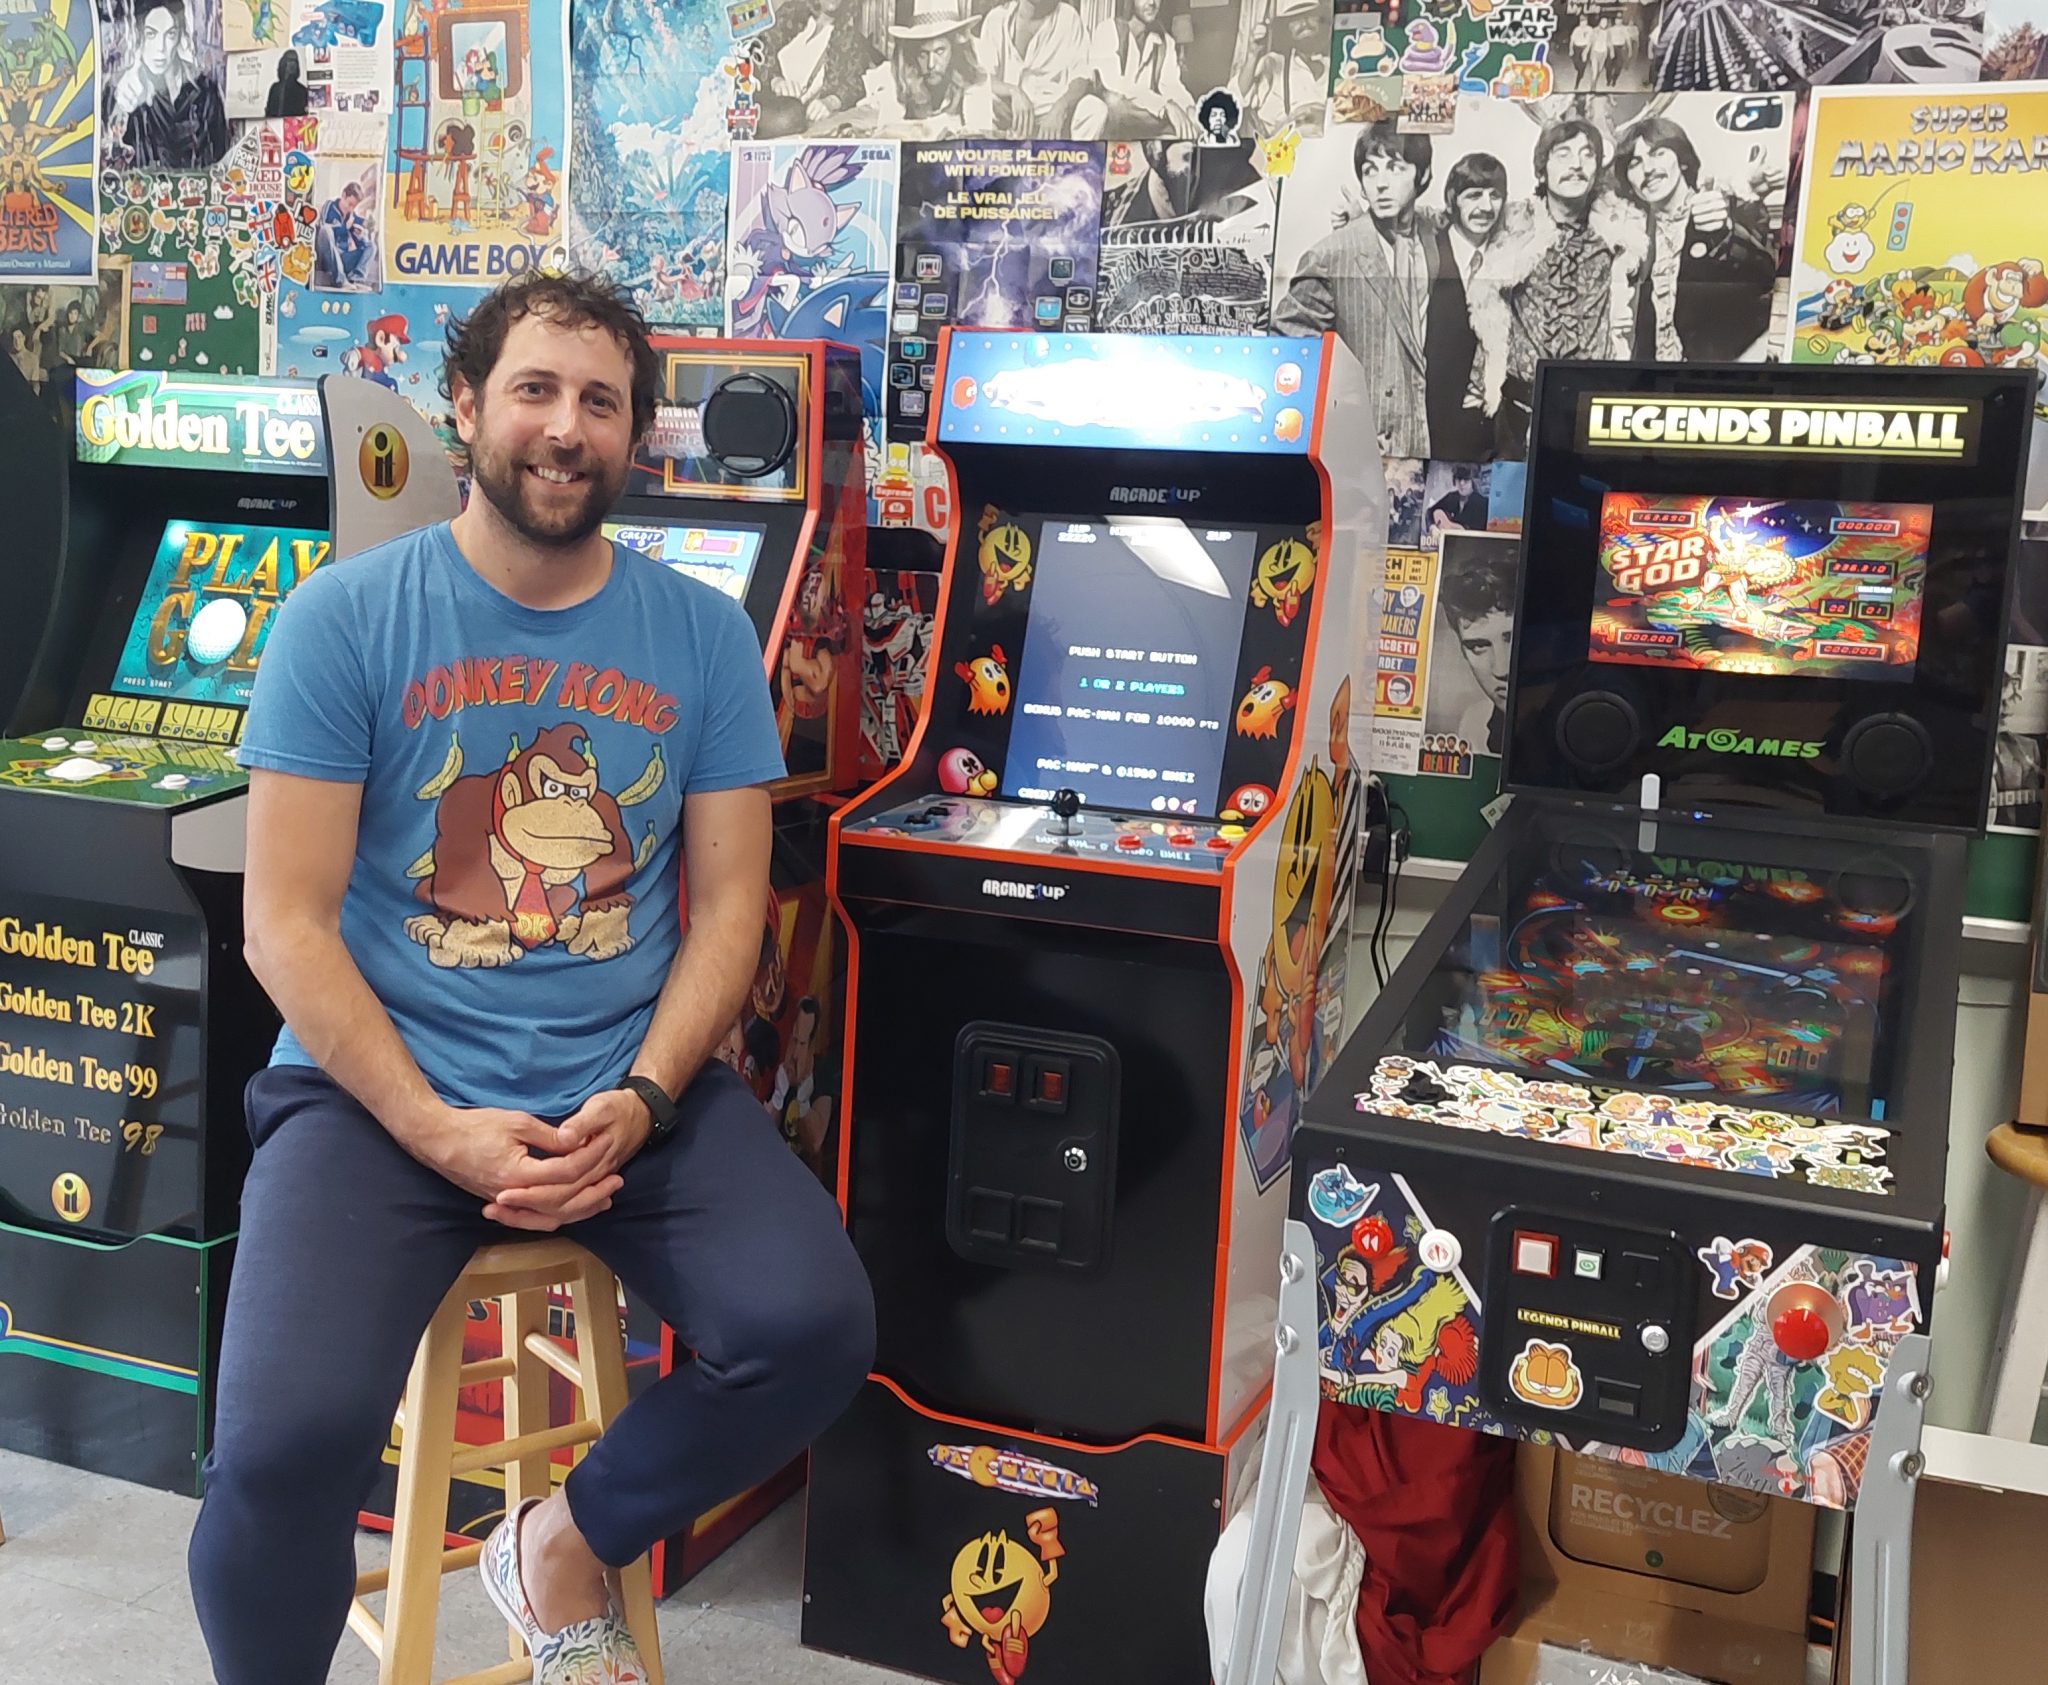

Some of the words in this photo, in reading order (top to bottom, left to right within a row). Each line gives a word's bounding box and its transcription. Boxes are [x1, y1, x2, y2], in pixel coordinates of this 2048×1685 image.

[1488, 7, 1554, 23] STAR
[1911, 104, 2008, 134] SUPER
[861, 150, 891, 161] SEGA
[916, 150, 951, 164] NOW
[956, 149, 1013, 162] YOU'RE
[1016, 149, 1088, 163] PLAYING
[944, 164, 985, 177] WITH
[989, 164, 1055, 177] POWER!
[1830, 138, 1968, 178] MARIO
[934, 206, 957, 219] DE
[960, 206, 1059, 220] PUISSANCE!
[947, 191, 969, 204] LE
[973, 191, 1012, 205] VRAI
[1016, 191, 1045, 205] JEU
[395, 243, 481, 276] GAME
[487, 243, 547, 276] BOY
[275, 393, 322, 417] CLASS
[81, 393, 231, 454] Golden
[235, 400, 317, 460] Tee
[1588, 404, 1772, 445] LEGENDS
[1780, 409, 1966, 452] PINBALL
[875, 485, 914, 498] Supreme
[620, 531, 661, 540] CREDIT
[167, 531, 330, 599] PLAY
[1612, 536, 1706, 571] STAR
[1619, 558, 1700, 592] GOD
[1068, 645, 1101, 658] PUSH
[1105, 648, 1145, 662] START
[1149, 652, 1198, 665] BUTTON
[122, 676, 146, 687] PRESS
[149, 678, 173, 689] START
[402, 654, 560, 731] DONKEY
[558, 661, 682, 735] KONG
[1079, 677, 1089, 688] 1
[1093, 678, 1111, 691] OR
[1115, 680, 1125, 692] 2
[1129, 681, 1186, 696] PLAYERS
[1023, 703, 1063, 717] BONUS
[1067, 706, 1121, 723] PAC-MAN
[1125, 710, 1151, 724] FOR
[1156, 714, 1196, 729] 10000
[1199, 720, 1220, 730] PTS
[1017, 787, 1056, 803] CREDI
[0, 916, 96, 968] Golden
[102, 930, 156, 977] Tee
[128, 928, 165, 950] CLASSIC
[0, 982, 72, 1023] Golden
[76, 994, 118, 1030] Tee
[120, 1001, 157, 1039] 2K
[79, 1055, 123, 1094] Tee
[124, 1062, 159, 1100] '99
[74, 1116, 113, 1145] Tee
[118, 1118, 165, 1157] '98
[1516, 1307, 1570, 1330] LEGENDS
[1571, 1319, 1622, 1340] PINBALL
[1570, 1483, 1733, 1540] RECYCLEZ
